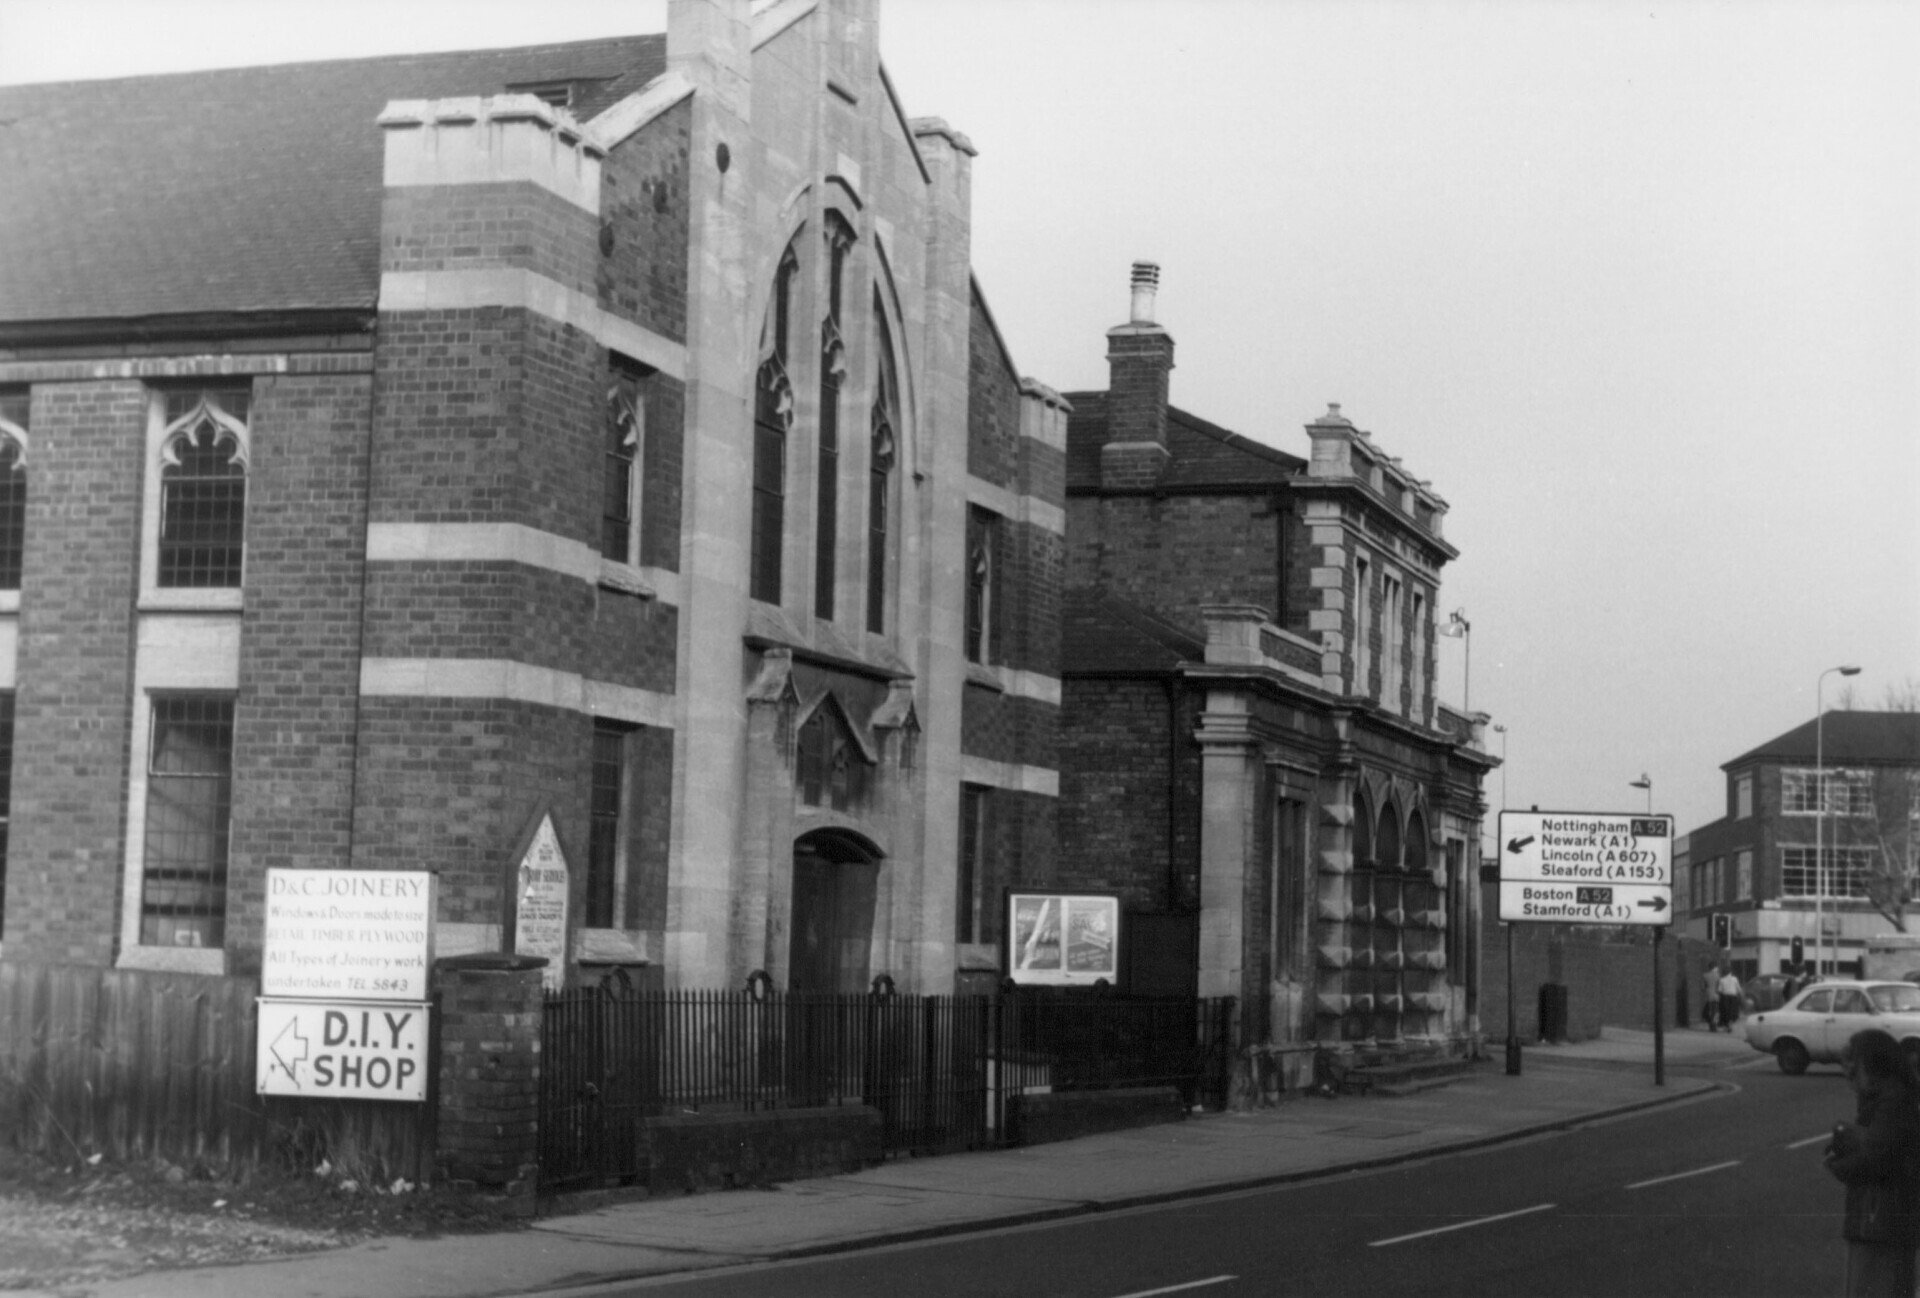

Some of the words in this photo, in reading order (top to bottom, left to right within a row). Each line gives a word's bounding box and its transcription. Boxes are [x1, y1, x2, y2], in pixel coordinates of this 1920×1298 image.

[1541, 819, 1628, 834] Nottingham
[1541, 834, 1597, 847] Newark
[1541, 849, 1594, 862] Lincoln
[1541, 863, 1603, 877] Sleaford
[320, 876, 424, 897] JOINERY
[1523, 887, 1573, 900] Boston
[329, 905, 361, 920] Doors
[1523, 902, 1591, 917] Stamford
[311, 928, 355, 942] TIMBER
[269, 950, 287, 963] All
[290, 950, 323, 968] Types
[326, 953, 337, 967] of
[340, 952, 391, 968] Joinery
[394, 954, 425, 968] work
[267, 974, 342, 989] undertaken
[372, 978, 408, 992] 5843
[323, 1010, 414, 1050] D.I.Y.
[314, 1055, 415, 1090] SHOP
